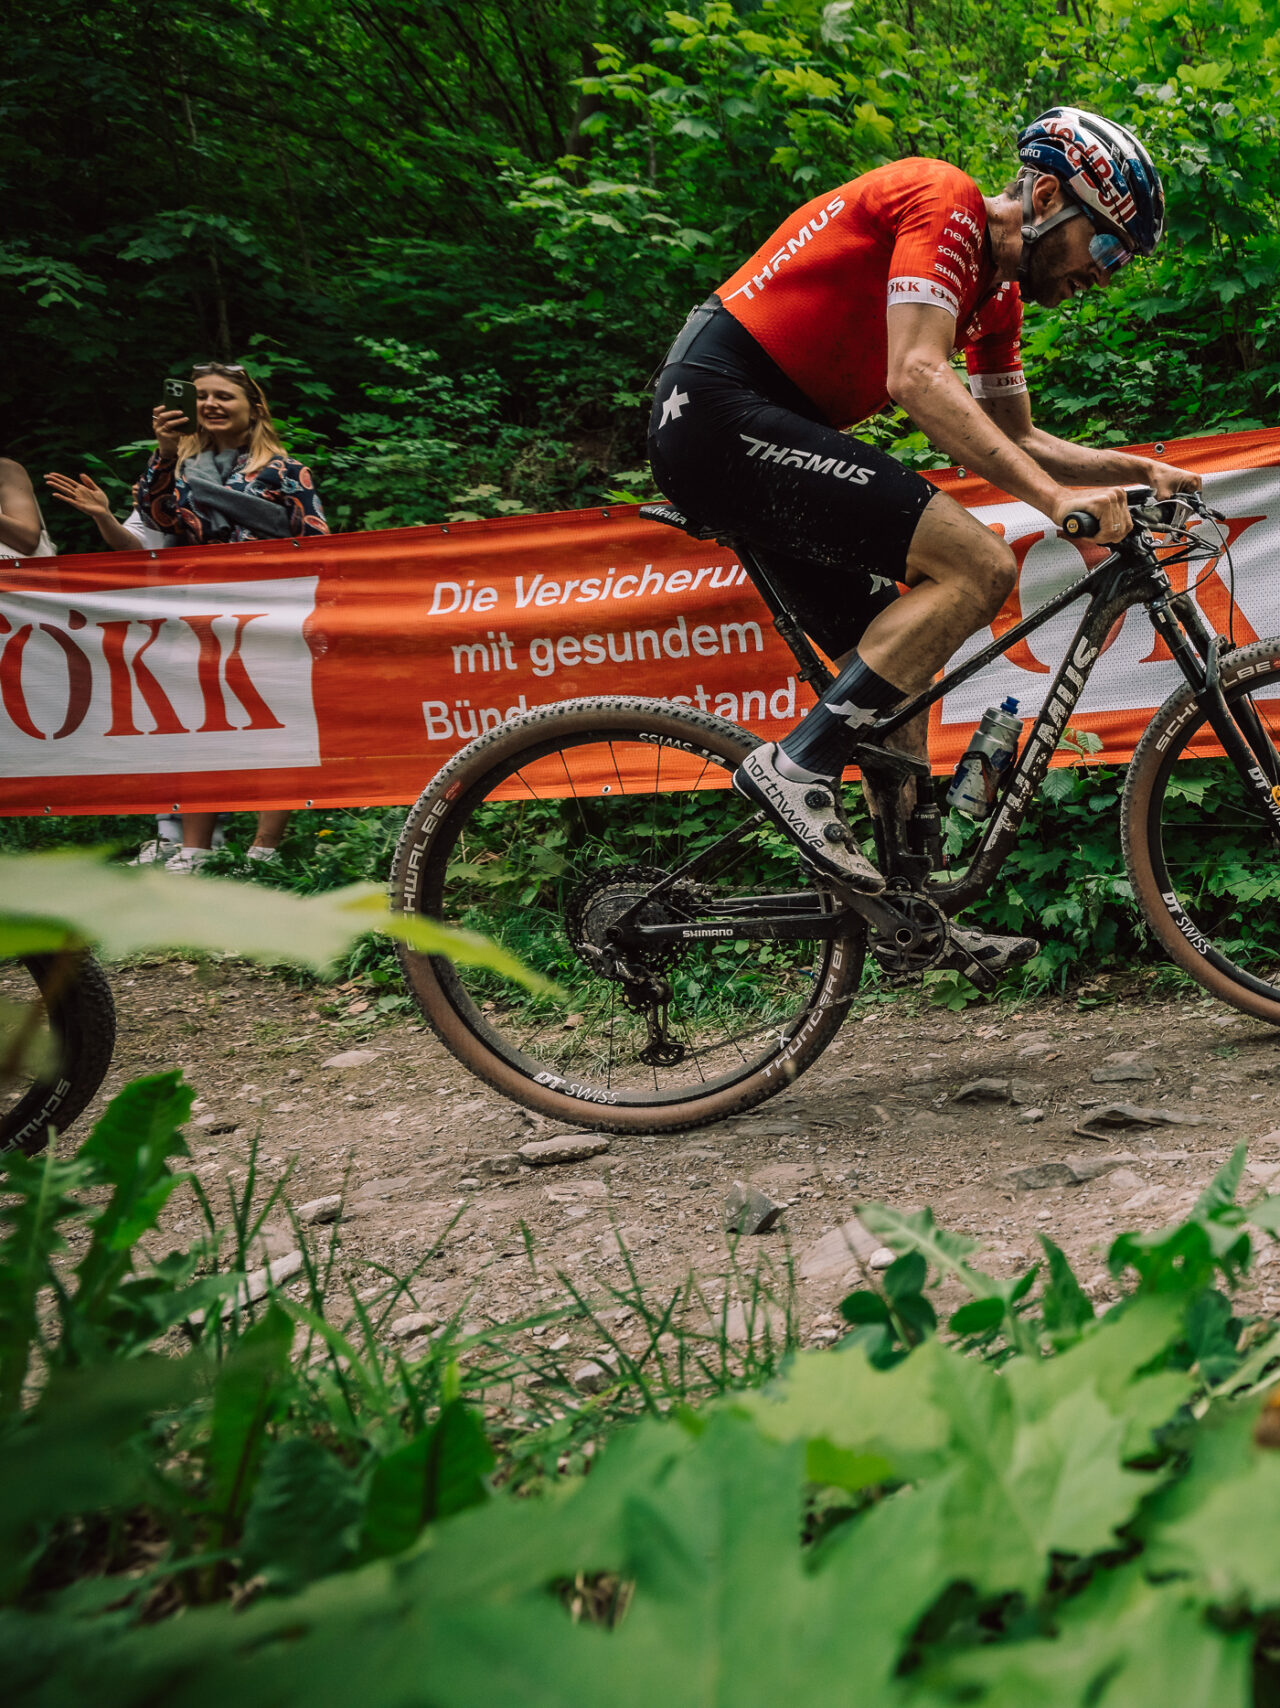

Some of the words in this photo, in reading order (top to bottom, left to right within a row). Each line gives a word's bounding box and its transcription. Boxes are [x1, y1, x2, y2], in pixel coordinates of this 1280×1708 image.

[1020, 148, 1040, 158] GIRO
[427, 580, 498, 615] Die
[514, 564, 748, 609] Versicheru
[451, 631, 518, 674] mit
[529, 616, 764, 677] gesundem
[0, 610, 286, 740] ÖKK
[639, 732, 693, 752] SWISS
[1248, 767, 1271, 789] DT
[746, 754, 825, 849] northwave
[683, 928, 734, 938] SHIMANO
[1162, 892, 1183, 913] DT
[1176, 917, 1211, 954] SWISS
[532, 1071, 566, 1089] DT
[565, 1083, 620, 1105] SWISS
